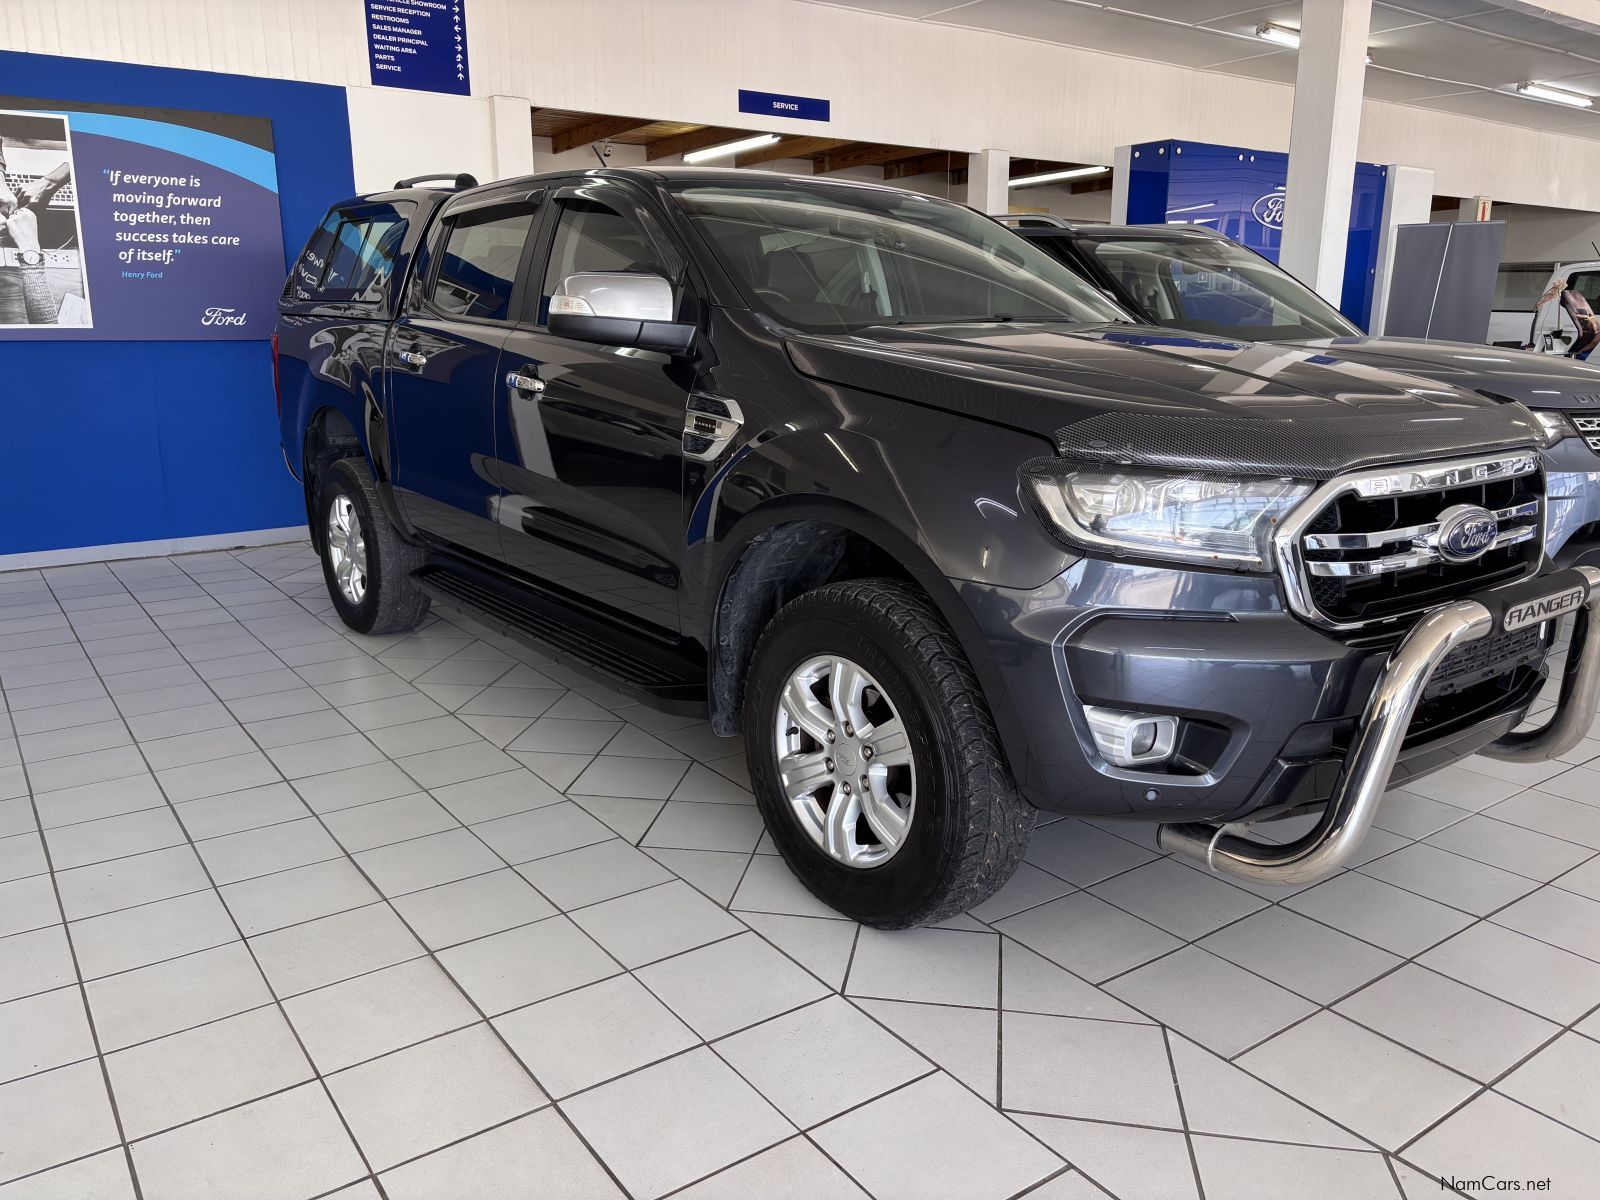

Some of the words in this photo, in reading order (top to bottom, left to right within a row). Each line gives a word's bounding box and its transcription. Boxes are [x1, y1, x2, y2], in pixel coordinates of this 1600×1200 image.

[370, 4, 396, 12] SERVICE
[397, 8, 431, 17] RECEPTION
[411, 0, 447, 10] SHOWROOM
[371, 14, 409, 24] RESTROOMS
[392, 27, 422, 35] MANAGER
[373, 34, 396, 42] DEALER
[397, 37, 428, 46] PRINCIPAL
[374, 44, 400, 52] WAITING
[773, 102, 798, 110] SERVICE
[123, 174, 186, 188] everyone
[189, 175, 200, 187] is
[113, 192, 163, 208] moving
[165, 193, 221, 208] forward
[1263, 198, 1285, 222] Fo
[113, 210, 177, 226] together,
[179, 213, 211, 225] then
[115, 232, 169, 242] success
[172, 232, 208, 244] takes
[211, 236, 240, 245] care
[118, 248, 134, 263] of
[122, 271, 145, 279] Henry
[146, 271, 163, 279] Ford
[201, 307, 247, 325] Ford
[1460, 519, 1493, 549] Ford
[1508, 590, 1582, 626] RANGER
